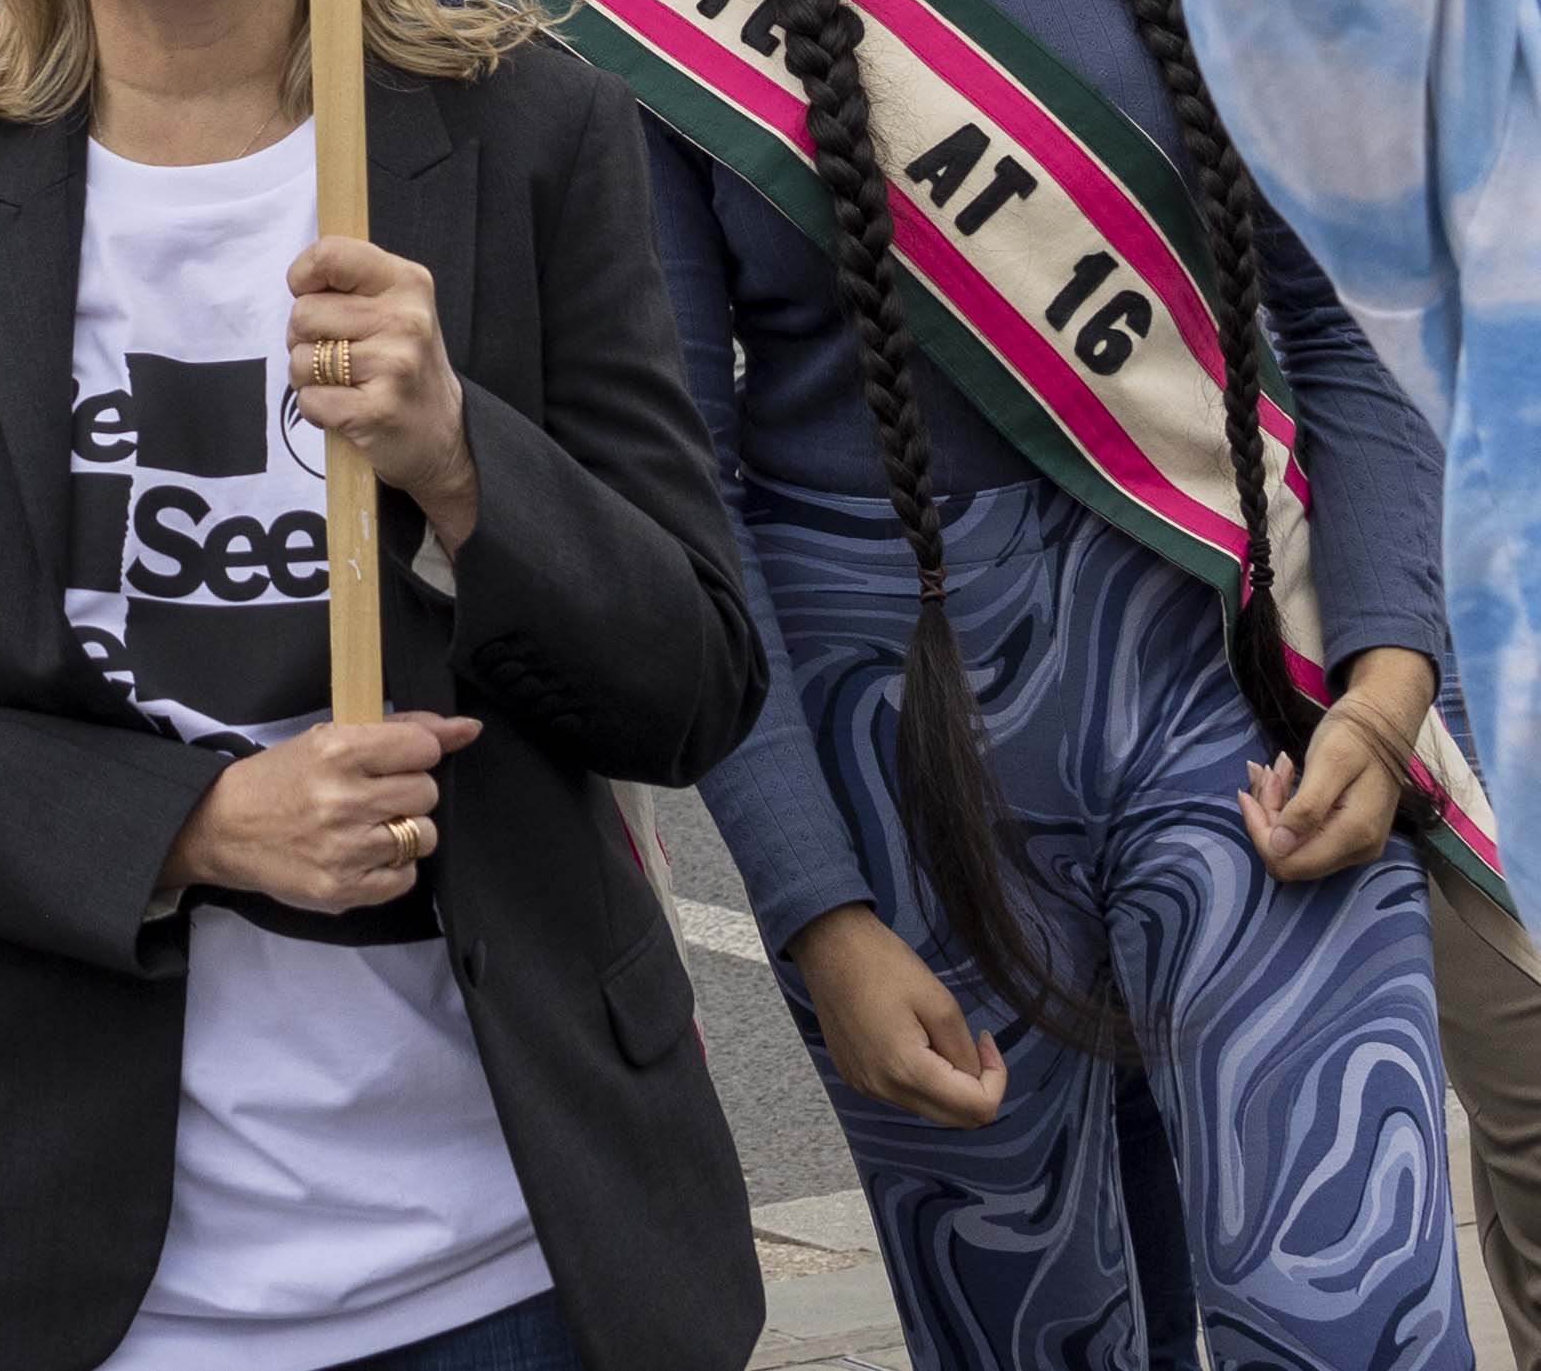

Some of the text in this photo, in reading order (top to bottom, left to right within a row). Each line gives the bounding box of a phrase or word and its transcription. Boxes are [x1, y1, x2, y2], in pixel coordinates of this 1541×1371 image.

[905, 122, 1037, 238] AT
[1044, 251, 1153, 378] 16
[71, 378, 139, 463] e
[125, 484, 330, 602] See
